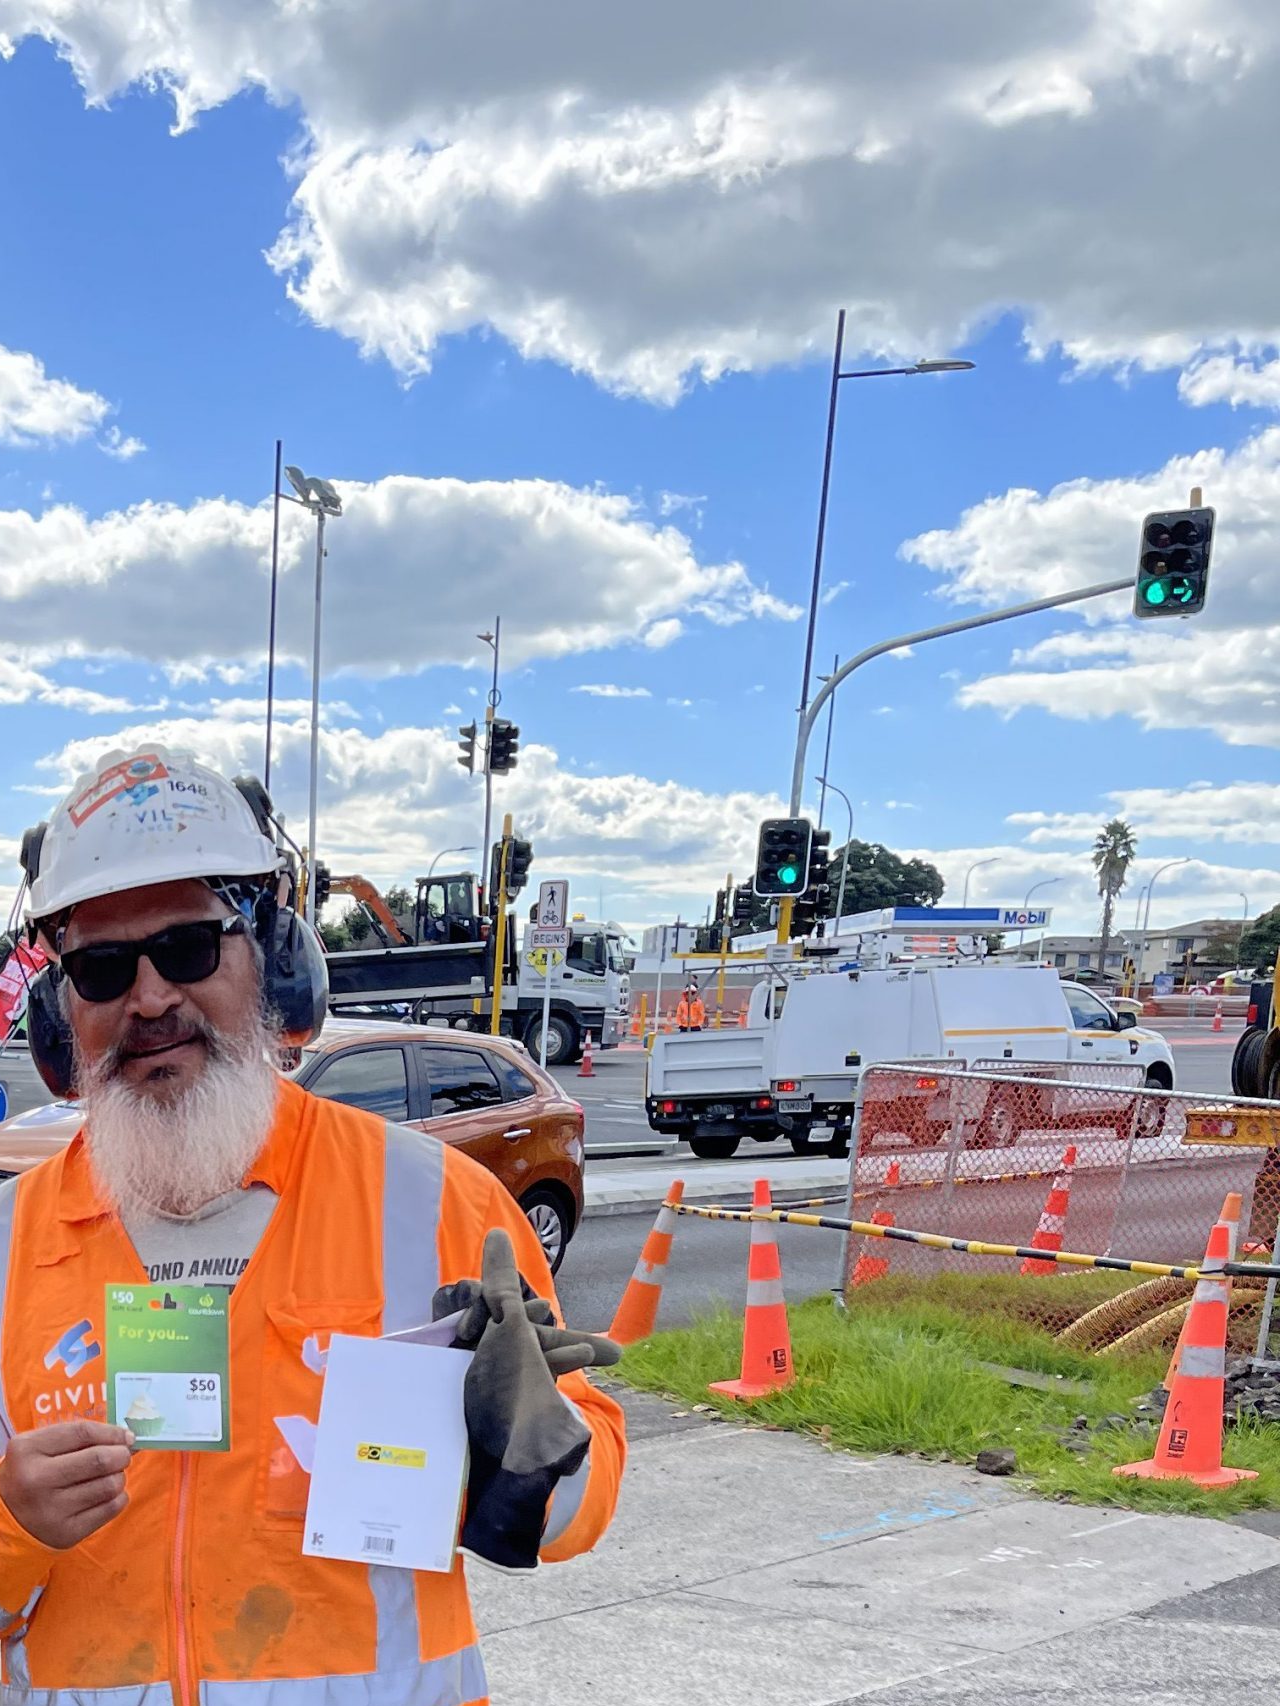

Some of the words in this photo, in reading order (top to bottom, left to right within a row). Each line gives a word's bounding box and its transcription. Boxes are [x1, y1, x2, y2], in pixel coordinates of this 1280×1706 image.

[168, 780, 208, 797] 1648
[1003, 911, 1046, 925] Mobil
[533, 933, 566, 944] BEGINS
[117, 1325, 144, 1339] For
[148, 1329, 189, 1343] you...
[189, 1378, 216, 1392] $50
[185, 1393, 199, 1401] Gift
[200, 1393, 217, 1401] Card
